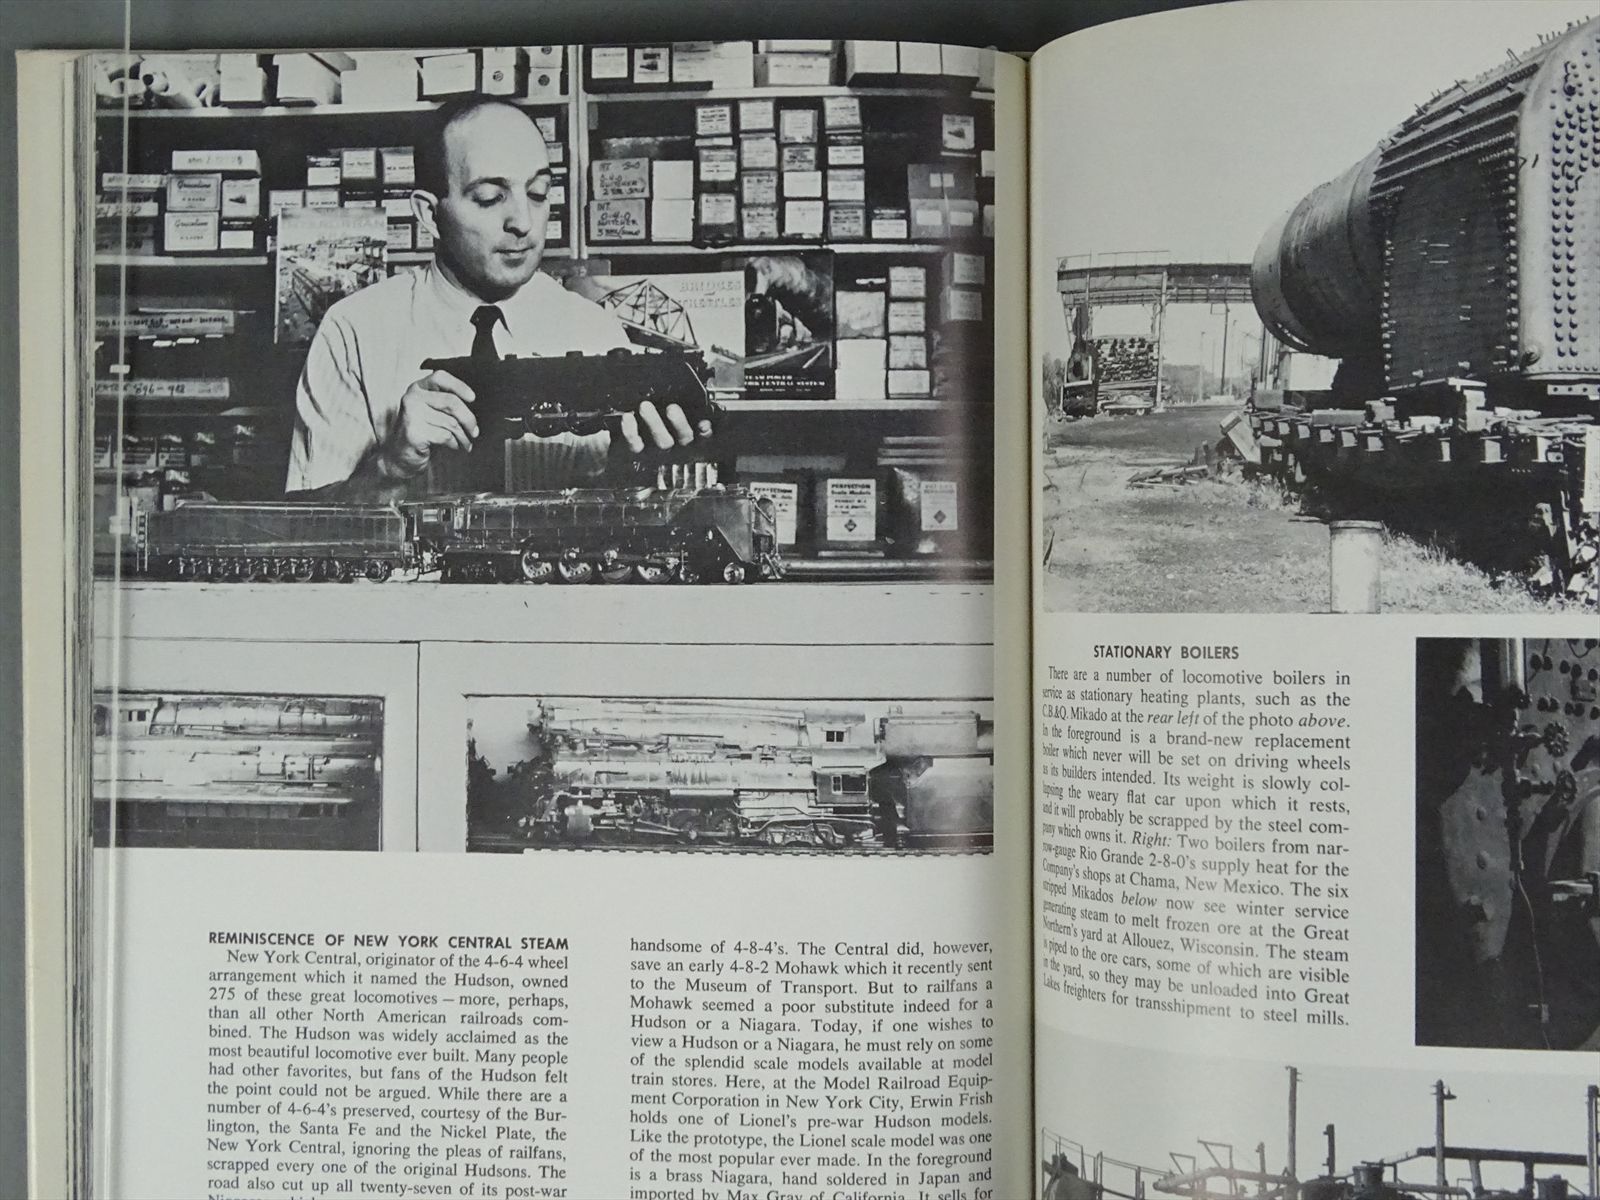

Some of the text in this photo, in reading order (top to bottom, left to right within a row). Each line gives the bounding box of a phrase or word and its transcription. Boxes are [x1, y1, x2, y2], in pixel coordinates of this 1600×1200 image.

[1093, 644, 1239, 660] STATIONARY BOILERS
[1073, 670, 1088, 680] are
[1093, 670, 1100, 681] a
[1105, 669, 1152, 682] number
[1159, 669, 1173, 683] of
[1182, 670, 1263, 684] locomotive
[1273, 671, 1326, 685] boilers
[1335, 674, 1351, 685] in
[1062, 745, 1087, 760] which
[1092, 750, 1122, 762] never
[1128, 750, 1151, 764] will
[1158, 751, 1173, 765] be
[1180, 753, 1200, 766] set
[1207, 756, 1226, 767] on
[1234, 754, 1288, 771] driving
[1296, 755, 1350, 770] wheels
[1057, 823, 1081, 838] which
[1084, 829, 1111, 842] owns
[1114, 830, 1126, 844] it.
[1131, 831, 1172, 848] Right:
[1180, 834, 1209, 849] Two
[1215, 836, 1265, 852] boilers
[1271, 839, 1310, 854] from
[1315, 843, 1349, 855] nar-
[1082, 866, 1111, 884] shops
[1114, 872, 1126, 884] at
[1129, 872, 1179, 890] Chama,
[1185, 876, 1217, 891] New
[1223, 879, 1284, 895] Mexico.
[1293, 883, 1321, 897] The
[1327, 887, 1349, 898] six
[208, 931, 569, 950] REMINISCENCE OF NEW YORK CENTRAL STEAM
[226, 950, 568, 969] New York Central, originator of the 4-6-4 wheel
[630, 958, 992, 976] save an early 4-8-2 Mohawk which it recently sent
[1063, 979, 1106, 1002] freighters
[1111, 989, 1129, 1006] for
[1135, 995, 1231, 1017] transshipment
[1239, 1006, 1255, 1019] to
[1263, 1008, 1297, 1022] steel
[1306, 1011, 1349, 1025] mills.
[208, 1007, 569, 1026] than all other North American railroads com-
[630, 1015, 994, 1034] Hudson or a Niagara. Today, if one wishes to
[208, 1063, 568, 1083] had other favorites, but fans of the Hudson felt
[630, 1073, 993, 1091] train stores. Here, at the Model Railroad Equip-
[629, 1110, 992, 1130] holds one of Lionel's pre-war Hudson models.
[207, 1120, 567, 1142] lington, the Santa Fe and the Nickel Plate, the
[628, 1148, 992, 1167] of the most popular ever made. In the foreground
